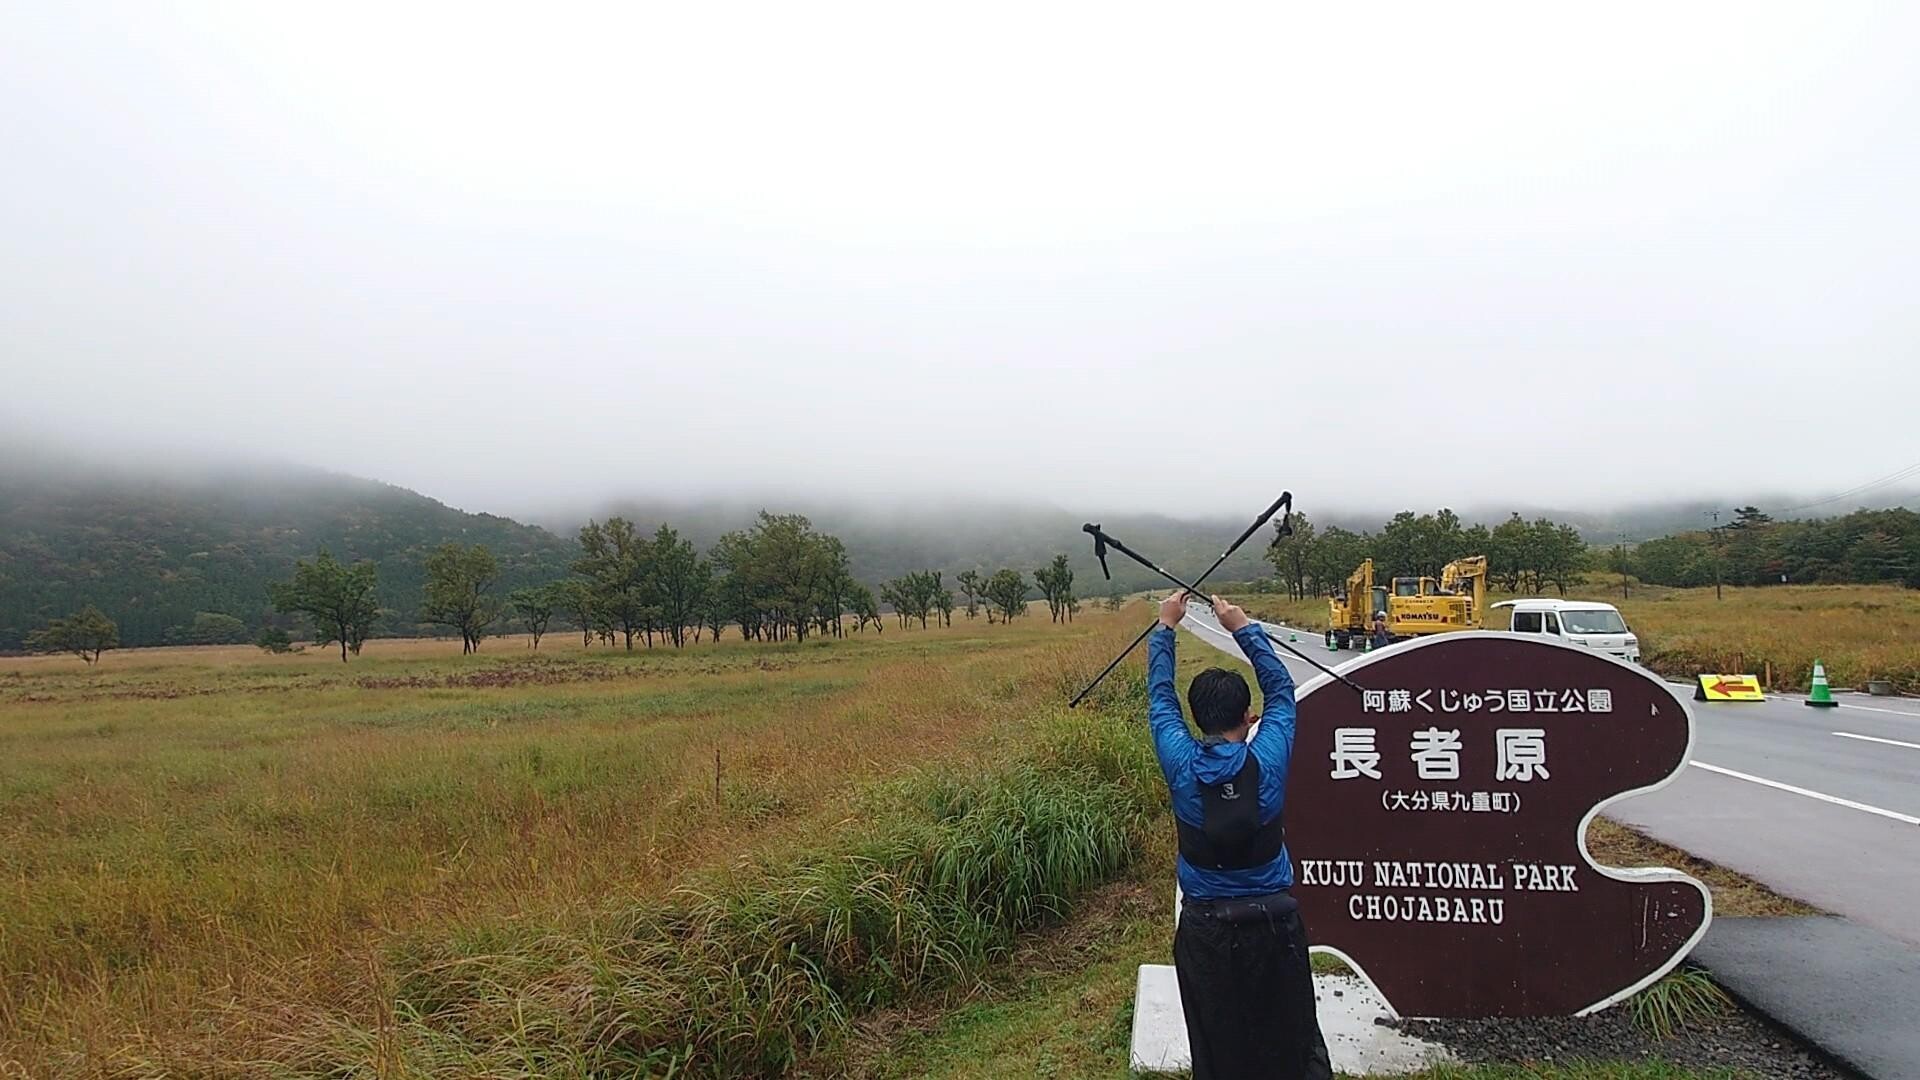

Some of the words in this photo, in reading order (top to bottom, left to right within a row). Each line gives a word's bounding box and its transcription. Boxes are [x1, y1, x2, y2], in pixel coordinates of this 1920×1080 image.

[1401, 611, 1439, 620] KOMATSU
[1362, 688, 1614, 714] 阿蘇くじゅう国立公園
[1330, 727, 1551, 783] 長者原
[1381, 791, 1522, 814] (大分県九重町)
[1300, 860, 1365, 888] KUJU
[1373, 861, 1505, 891] NATIONAL
[1513, 864, 1580, 893] PARK
[1348, 894, 1506, 926] CHOJABARU
